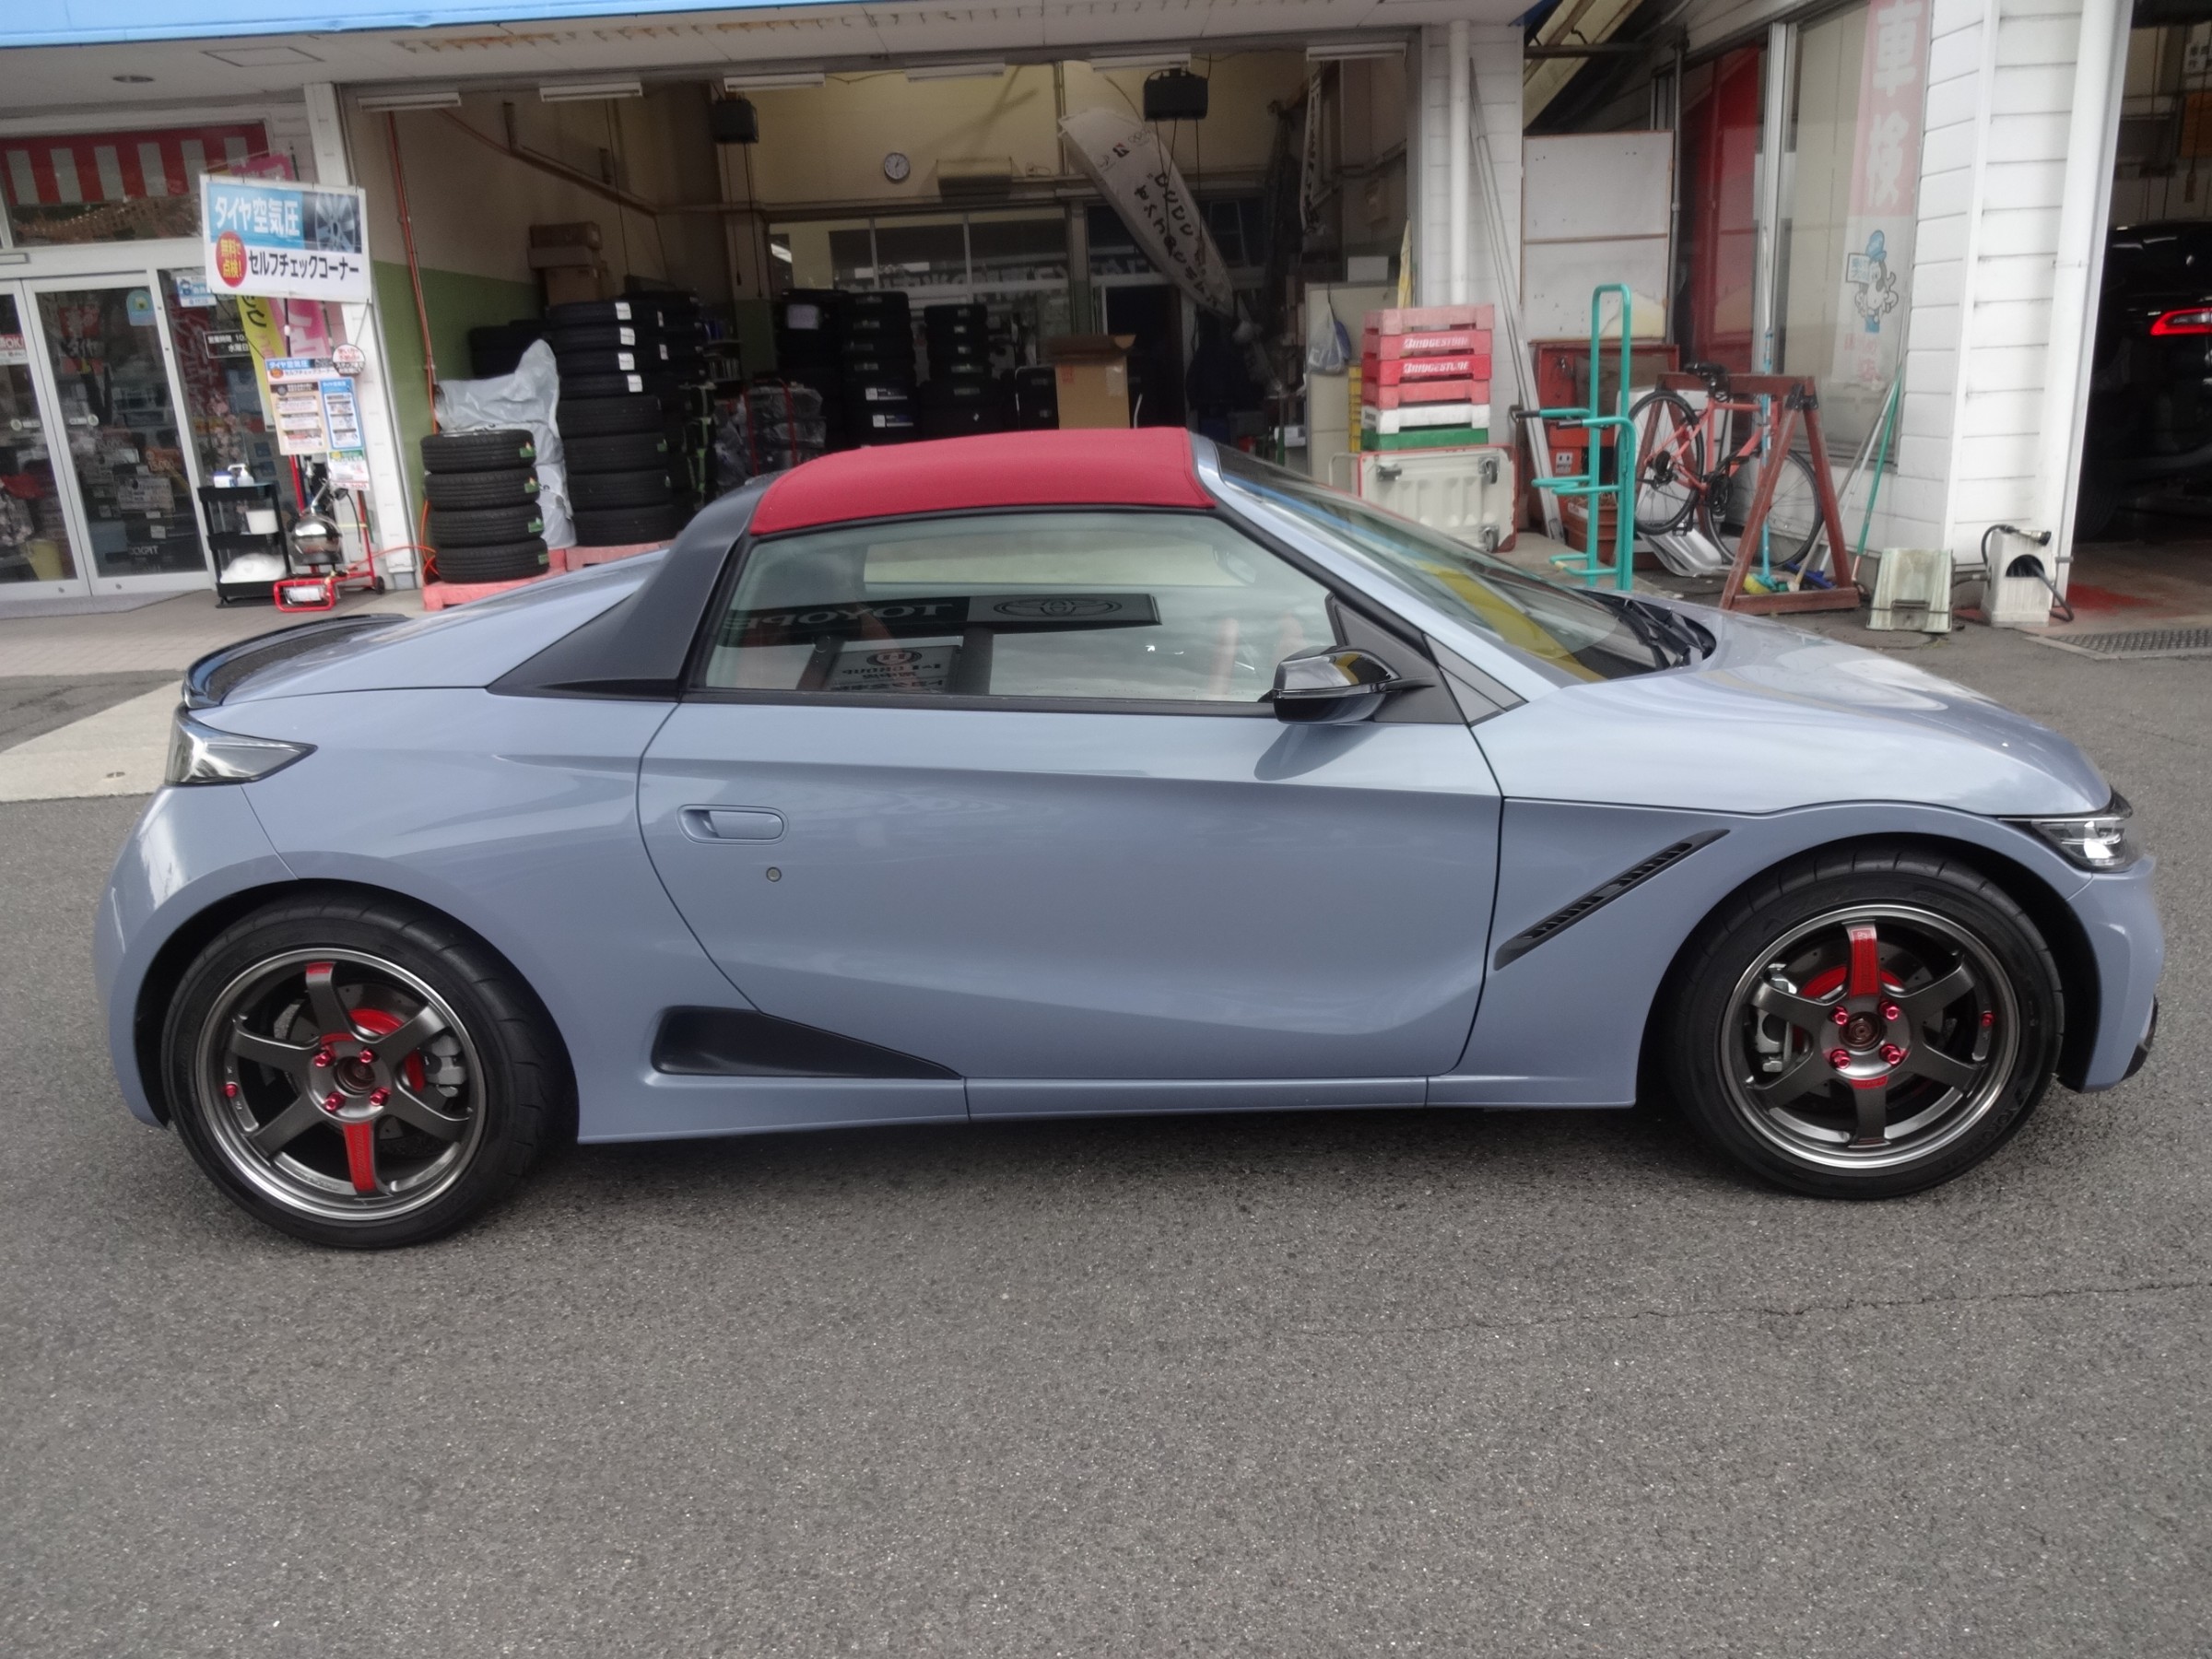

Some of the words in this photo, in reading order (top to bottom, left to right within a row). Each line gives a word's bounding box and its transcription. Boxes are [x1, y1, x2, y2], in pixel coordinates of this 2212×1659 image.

[1865, 0, 1923, 208] 車検
[215, 195, 301, 237] タイヤ空気圧
[219, 239, 241, 256] 無料で
[248, 250, 359, 281] セルフチェックコーナー
